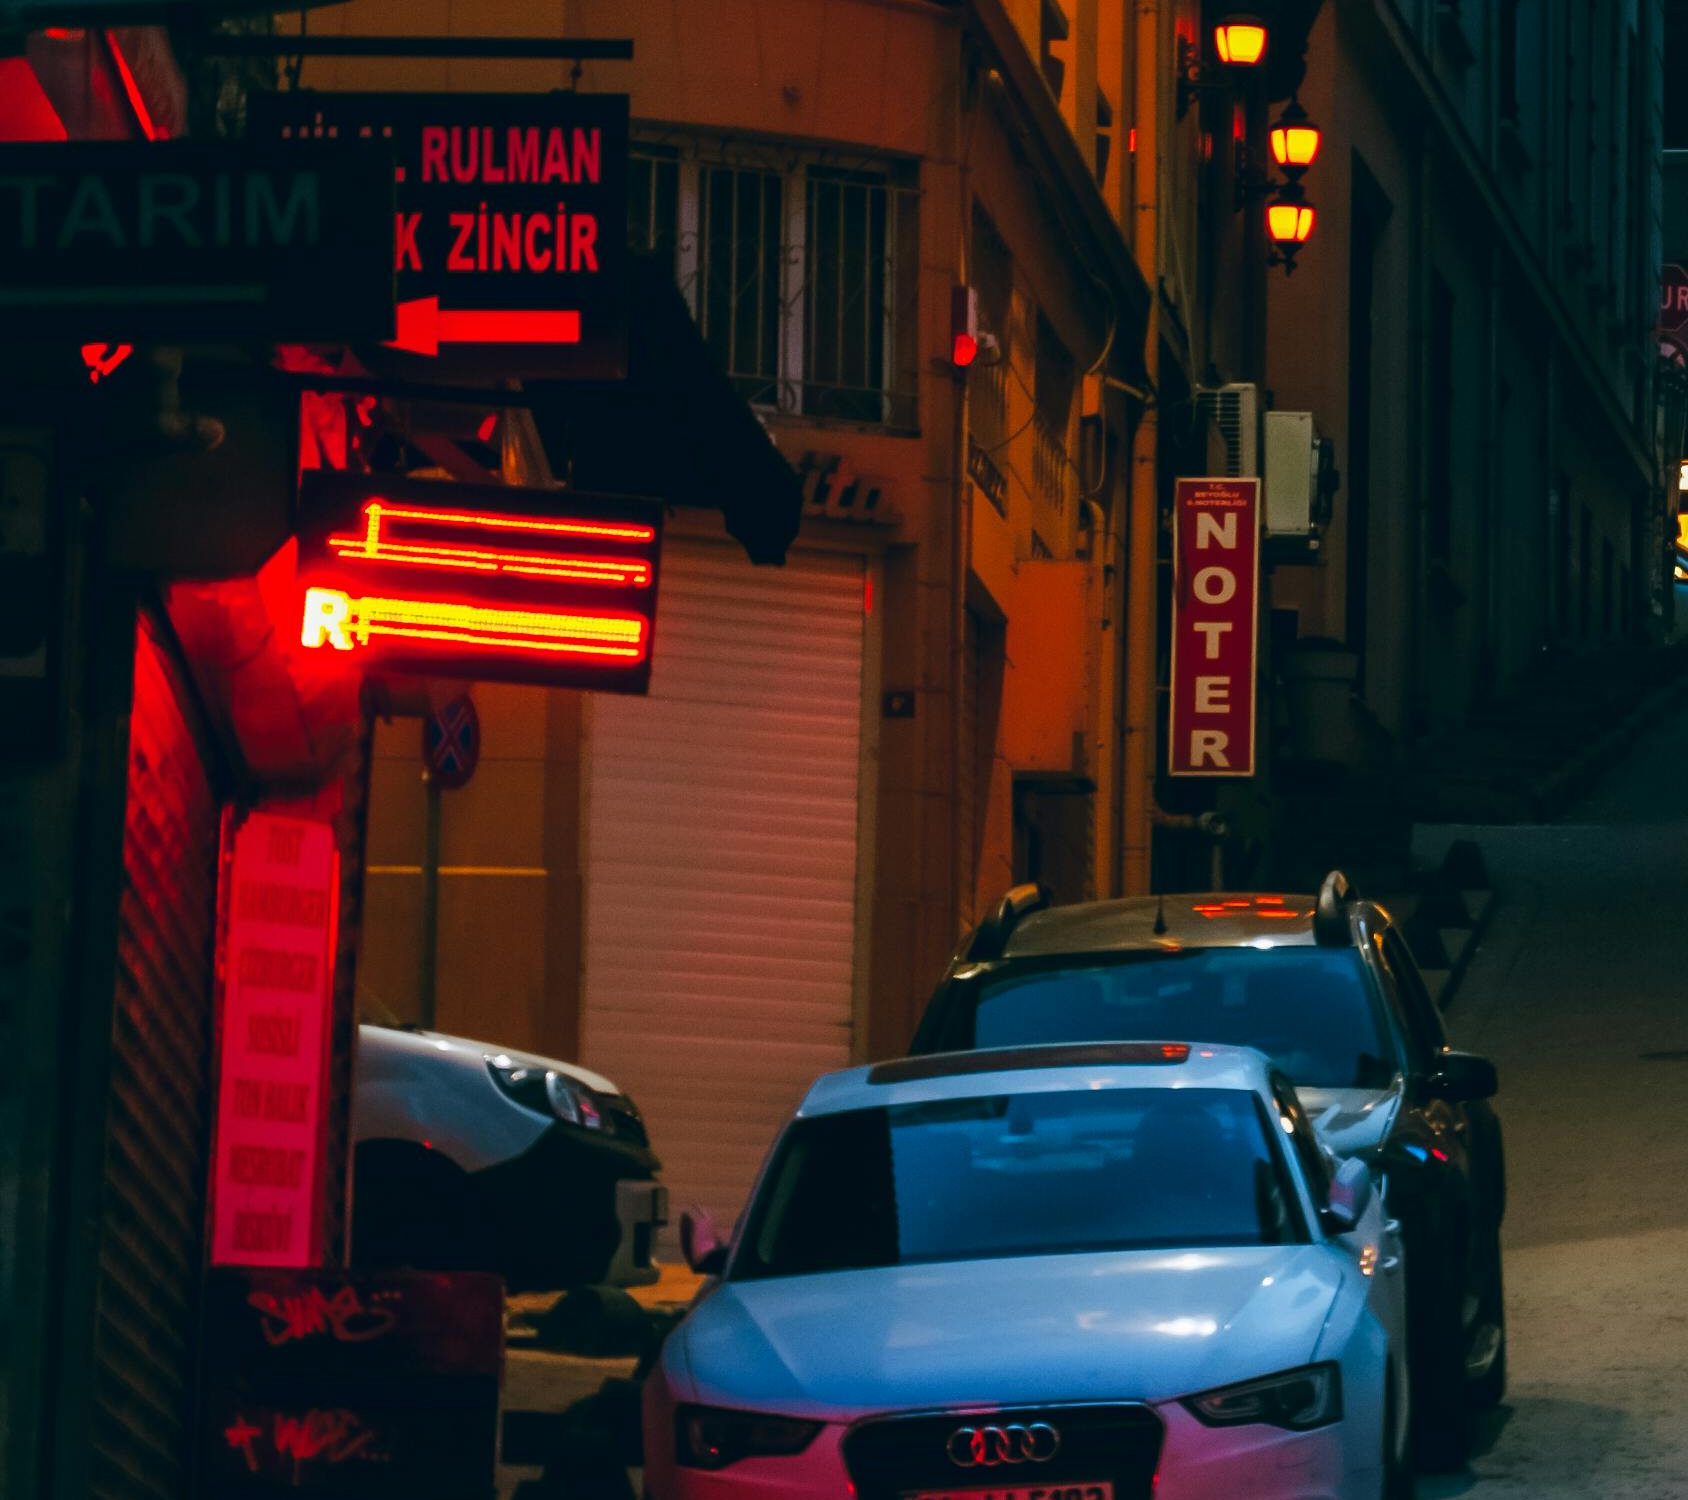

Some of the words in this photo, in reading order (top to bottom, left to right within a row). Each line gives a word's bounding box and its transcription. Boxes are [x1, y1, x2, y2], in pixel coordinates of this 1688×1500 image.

[421, 124, 601, 184] RULMAN
[0, 169, 321, 250] TARIM
[446, 201, 600, 274] ZİNCİR
[1188, 511, 1239, 769] NOTER
